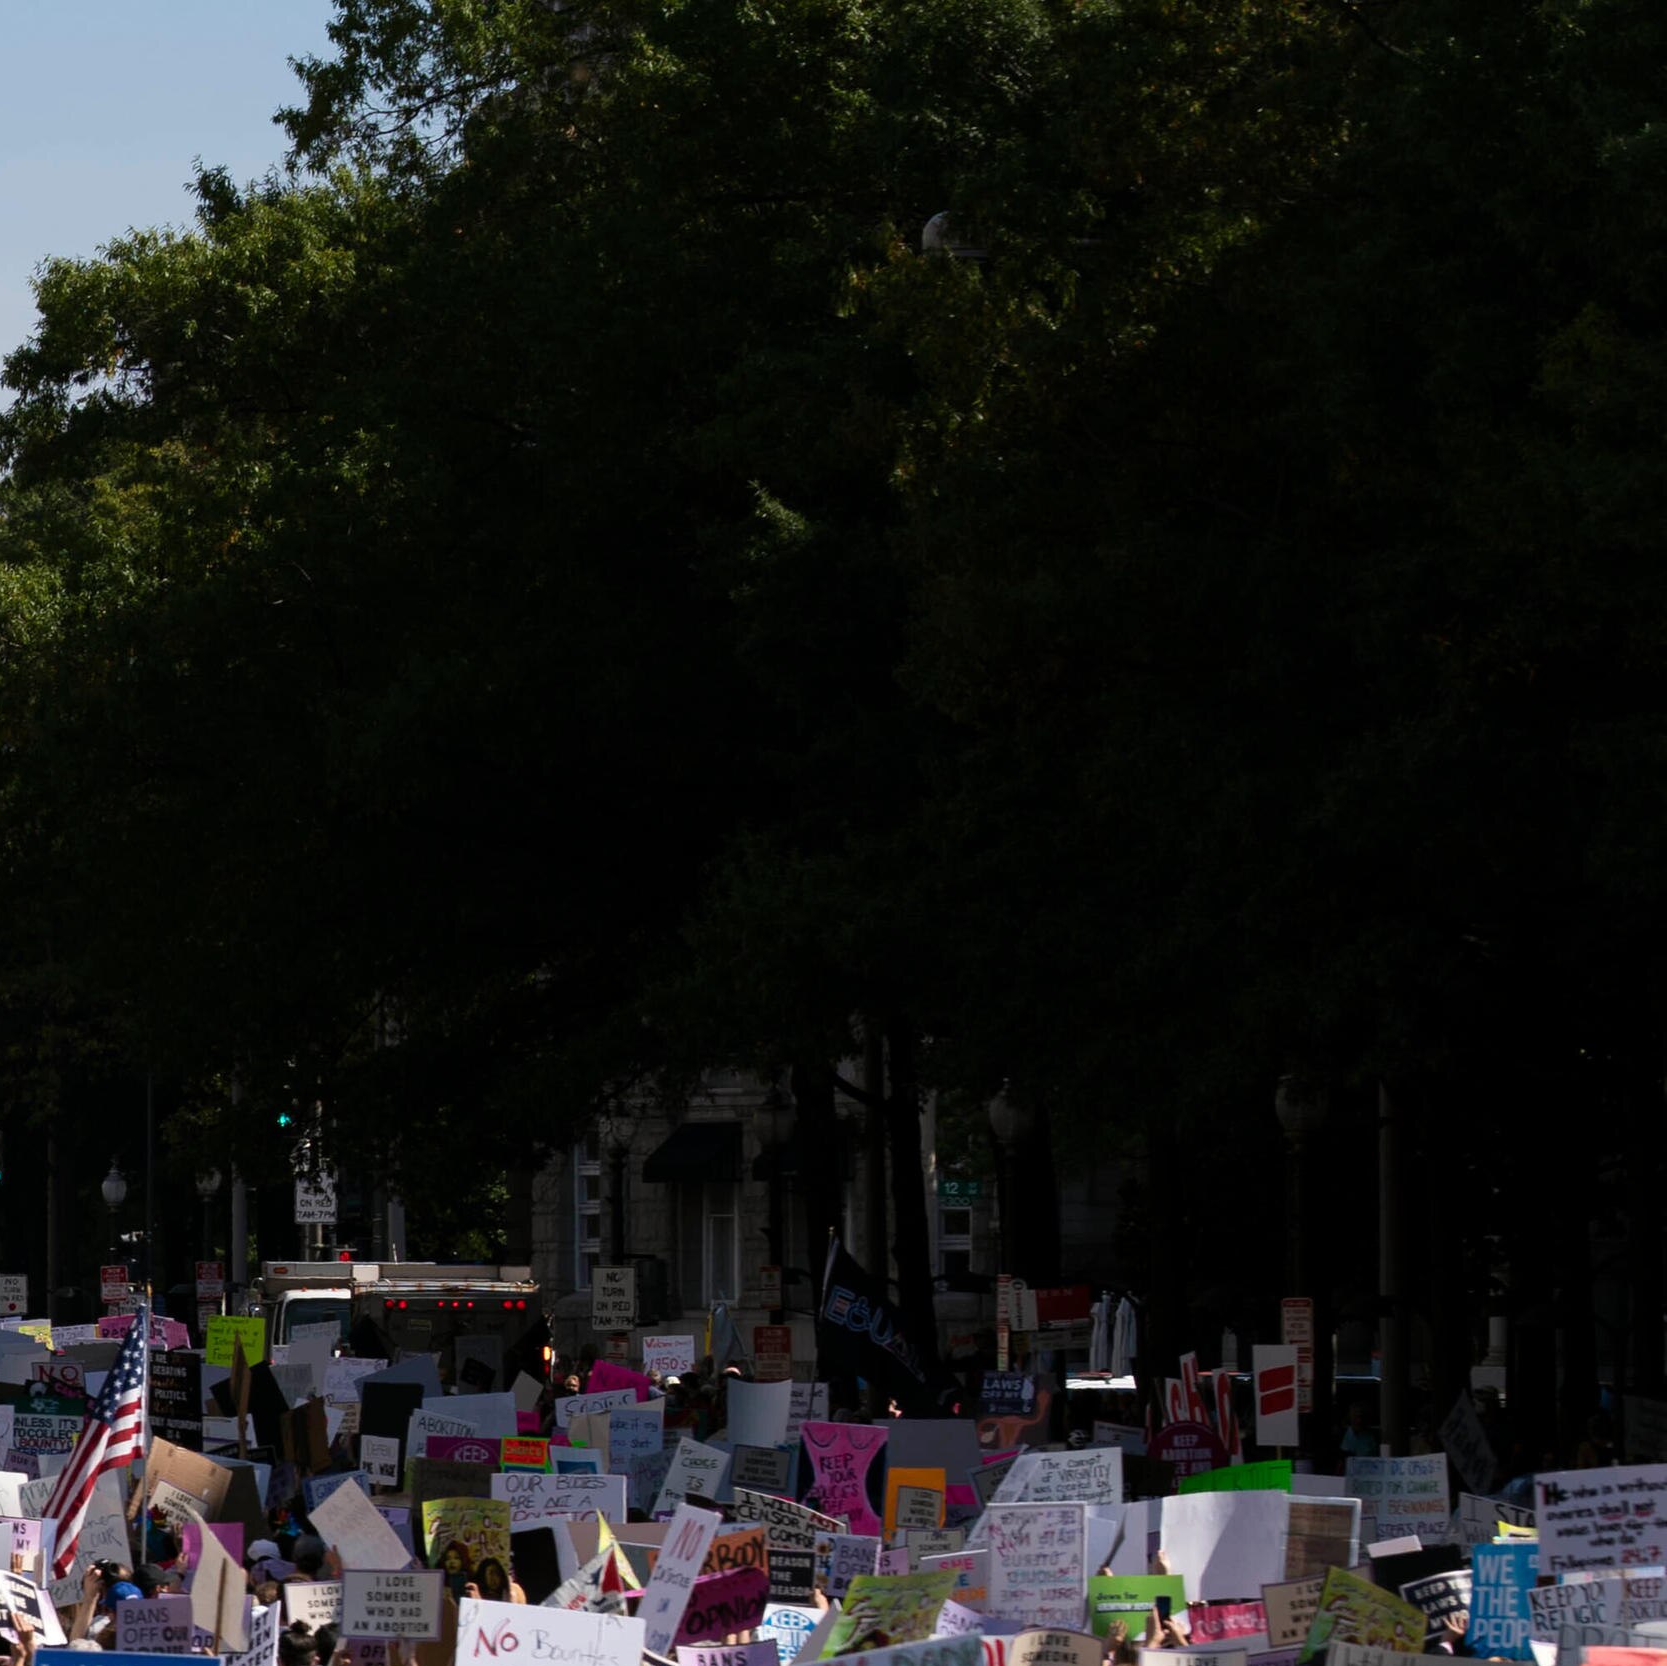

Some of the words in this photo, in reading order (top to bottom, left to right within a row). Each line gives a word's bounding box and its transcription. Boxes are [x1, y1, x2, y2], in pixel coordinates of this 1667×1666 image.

[606, 1272, 619, 1282] NO
[602, 1287, 625, 1297] TURN
[596, 1302, 608, 1311] ON
[612, 1302, 630, 1311] RED
[983, 1379, 1022, 1391] LAWS
[453, 1446, 489, 1462] KEEP
[505, 1475, 545, 1493] OUR
[1478, 1555, 1515, 1585] WE
[375, 1576, 380, 1588] I
[384, 1576, 415, 1588] LOVE
[366, 1591, 422, 1602] SOMEONE
[1474, 1586, 1520, 1616] THE
[366, 1606, 394, 1618] WHO
[399, 1607, 422, 1618] HAD
[352, 1621, 370, 1632] AN
[1474, 1619, 1536, 1648] PEOP
